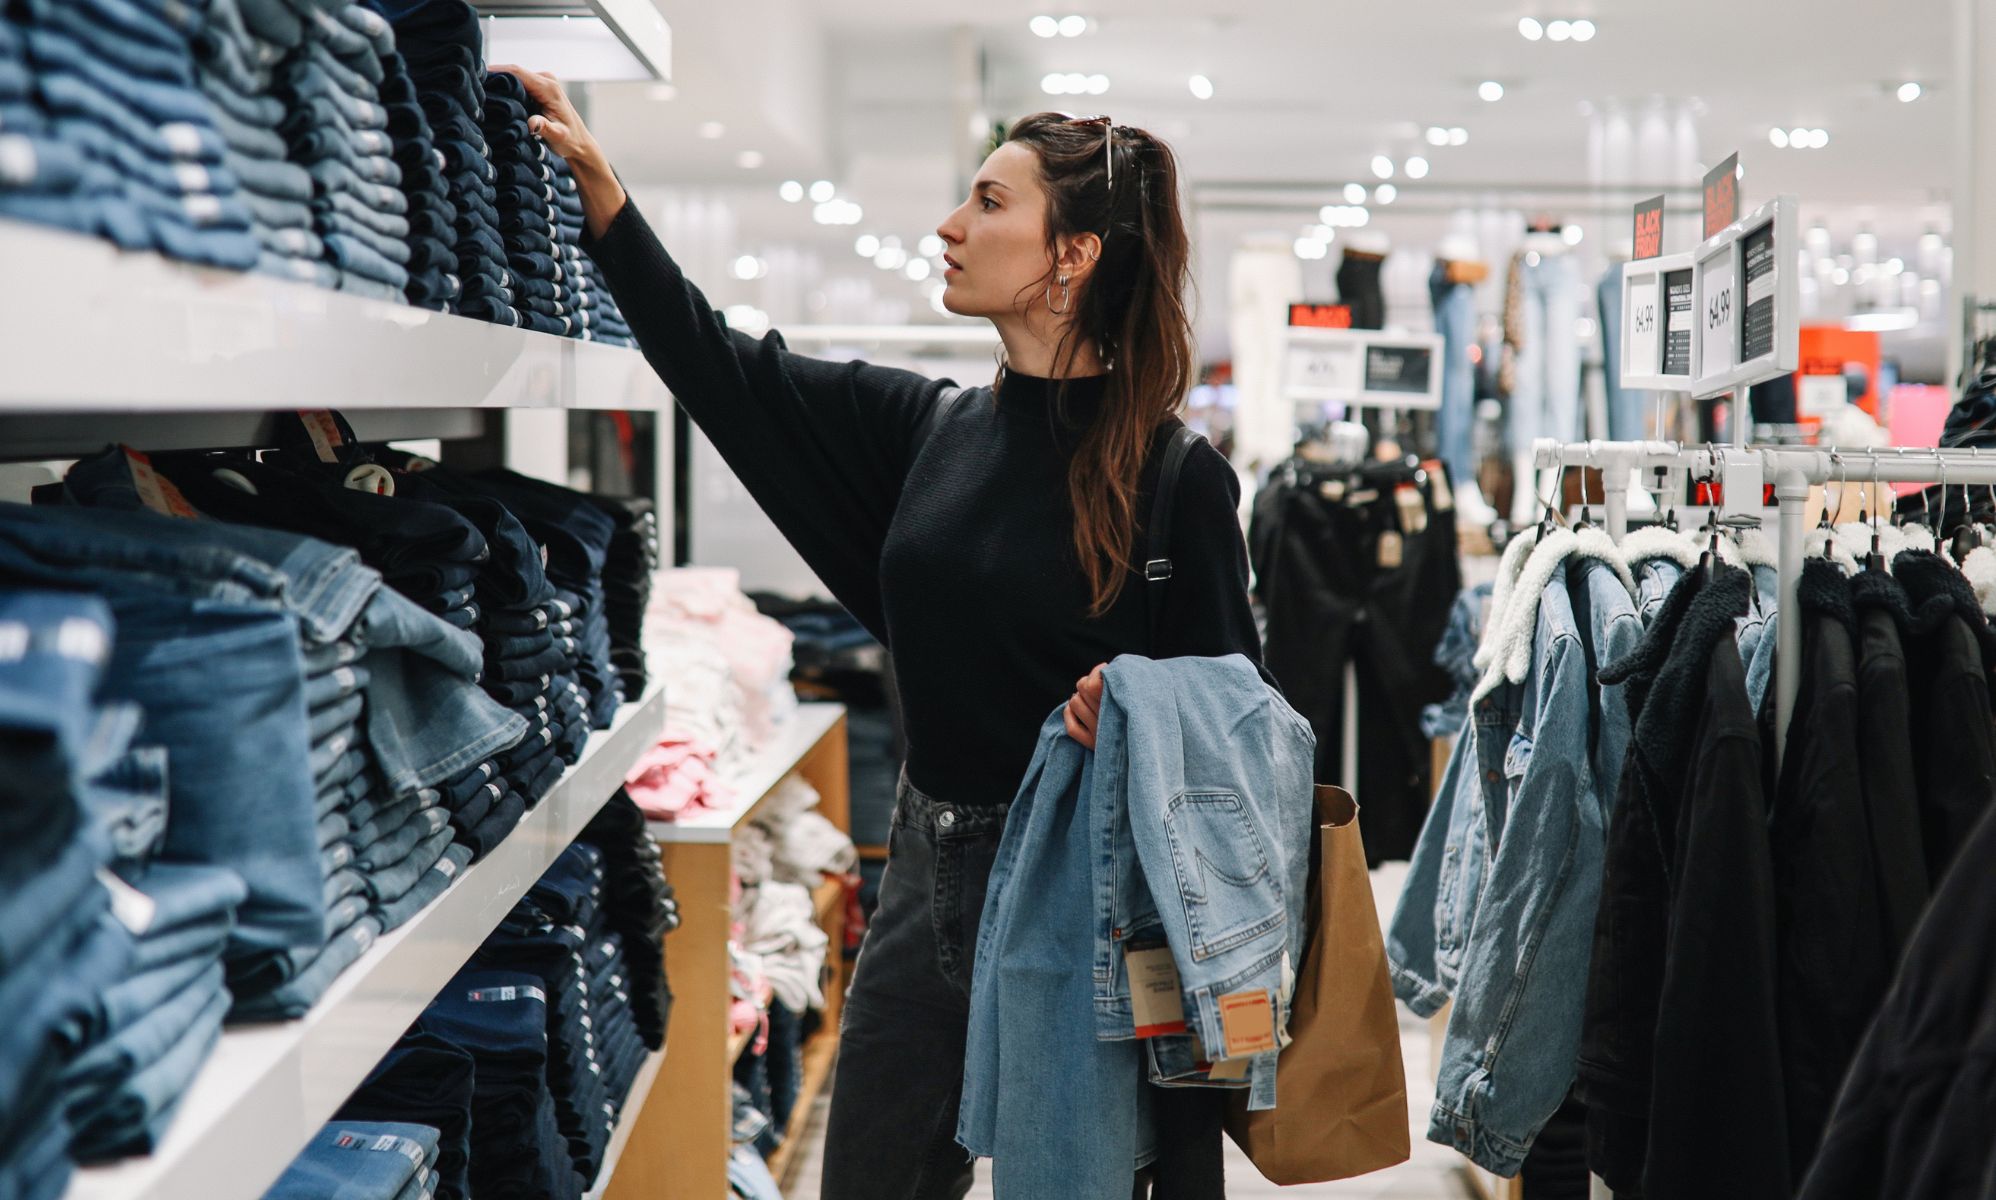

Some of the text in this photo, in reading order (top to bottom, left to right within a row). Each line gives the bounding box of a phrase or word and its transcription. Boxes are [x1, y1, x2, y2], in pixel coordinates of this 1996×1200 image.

[1706, 172, 1735, 210] BLACK
[1636, 208, 1661, 234] BLACK
[1635, 232, 1659, 258] FRIDAY
[1636, 304, 1654, 333] 64.99
[1709, 288, 1731, 329] 64.99
